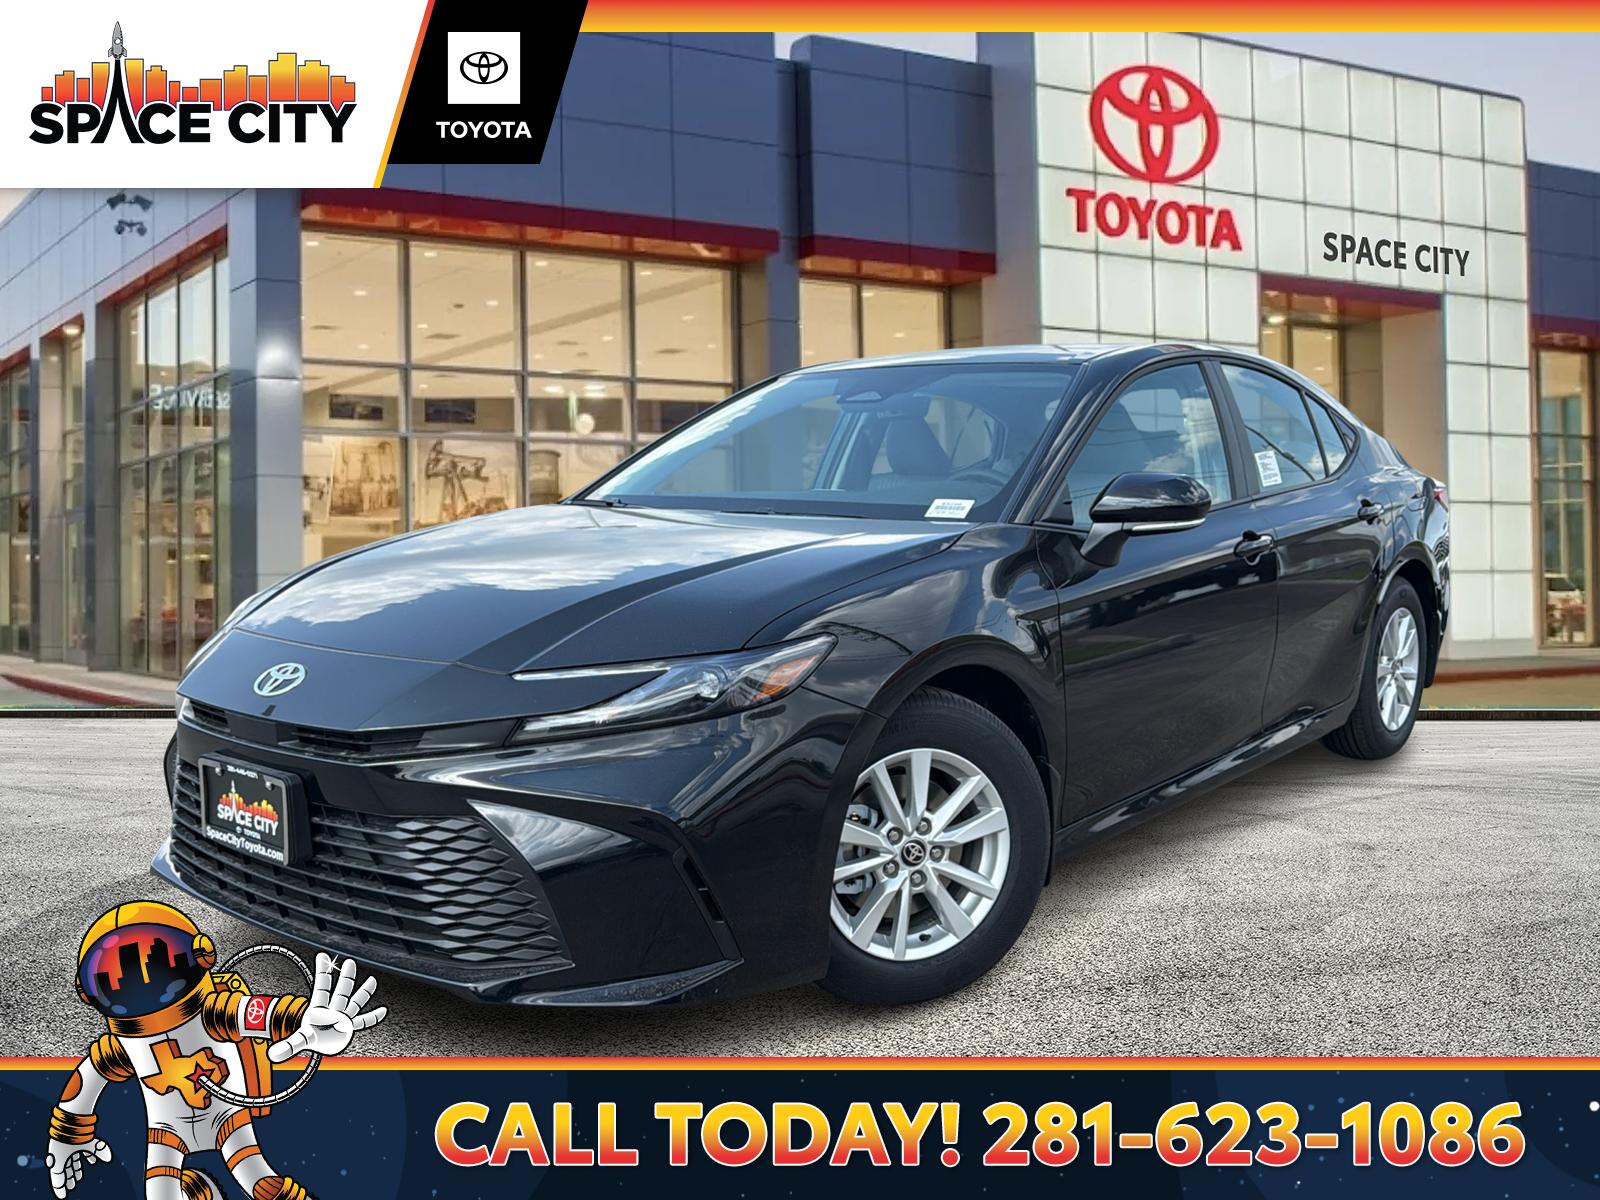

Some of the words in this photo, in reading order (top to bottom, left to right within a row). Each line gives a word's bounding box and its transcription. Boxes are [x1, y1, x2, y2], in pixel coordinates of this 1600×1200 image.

[1065, 187, 1243, 251] TOYOTA
[1323, 232, 1407, 270] SPACE
[1414, 244, 1470, 277] CITY
[217, 803, 253, 827] SPACE
[254, 815, 279, 836] CITY
[206, 825, 284, 861] SpaceCityToyota.com
